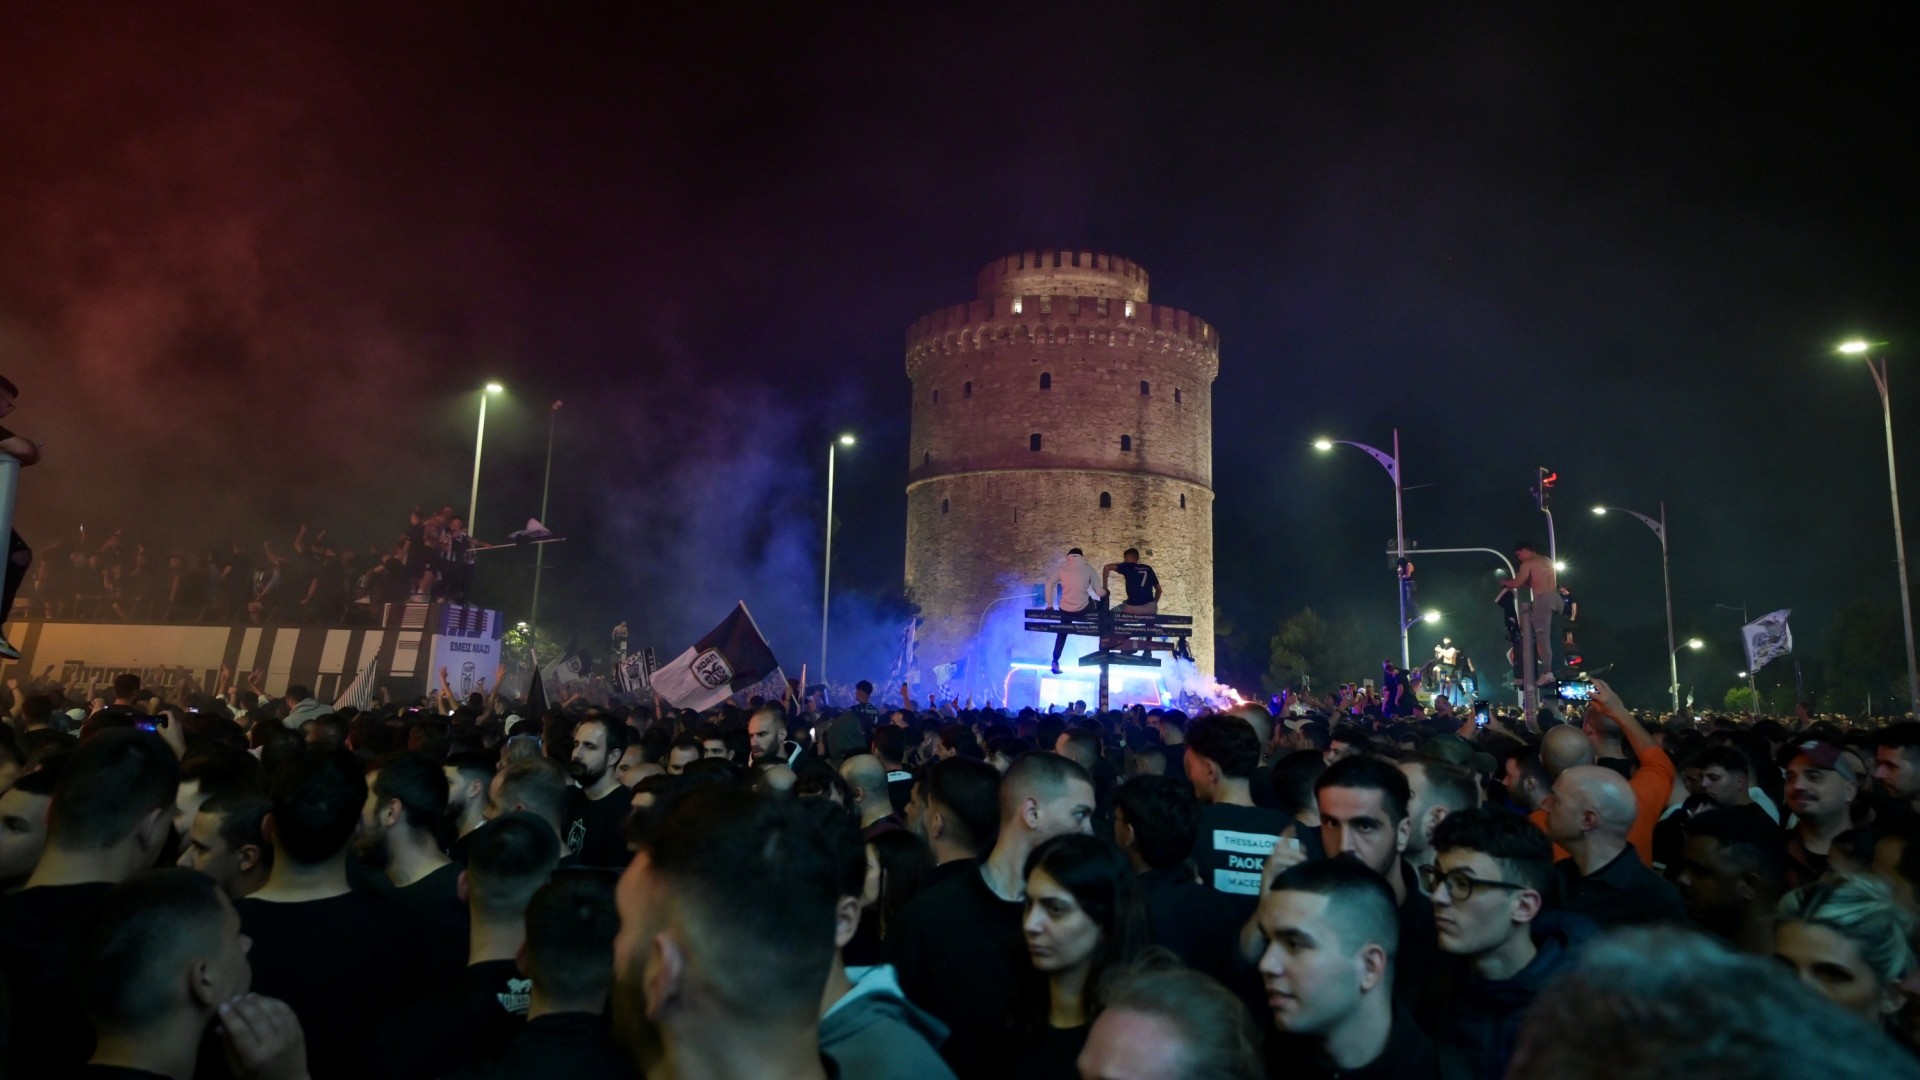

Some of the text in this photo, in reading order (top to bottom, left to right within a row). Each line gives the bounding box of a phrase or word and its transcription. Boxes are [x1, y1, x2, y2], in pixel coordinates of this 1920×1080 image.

[1138, 571, 1147, 587] 7
[450, 641, 490, 654] ΕΜΕΙΣ ΜΑΖΙ
[1228, 855, 1264, 870] PAOK
